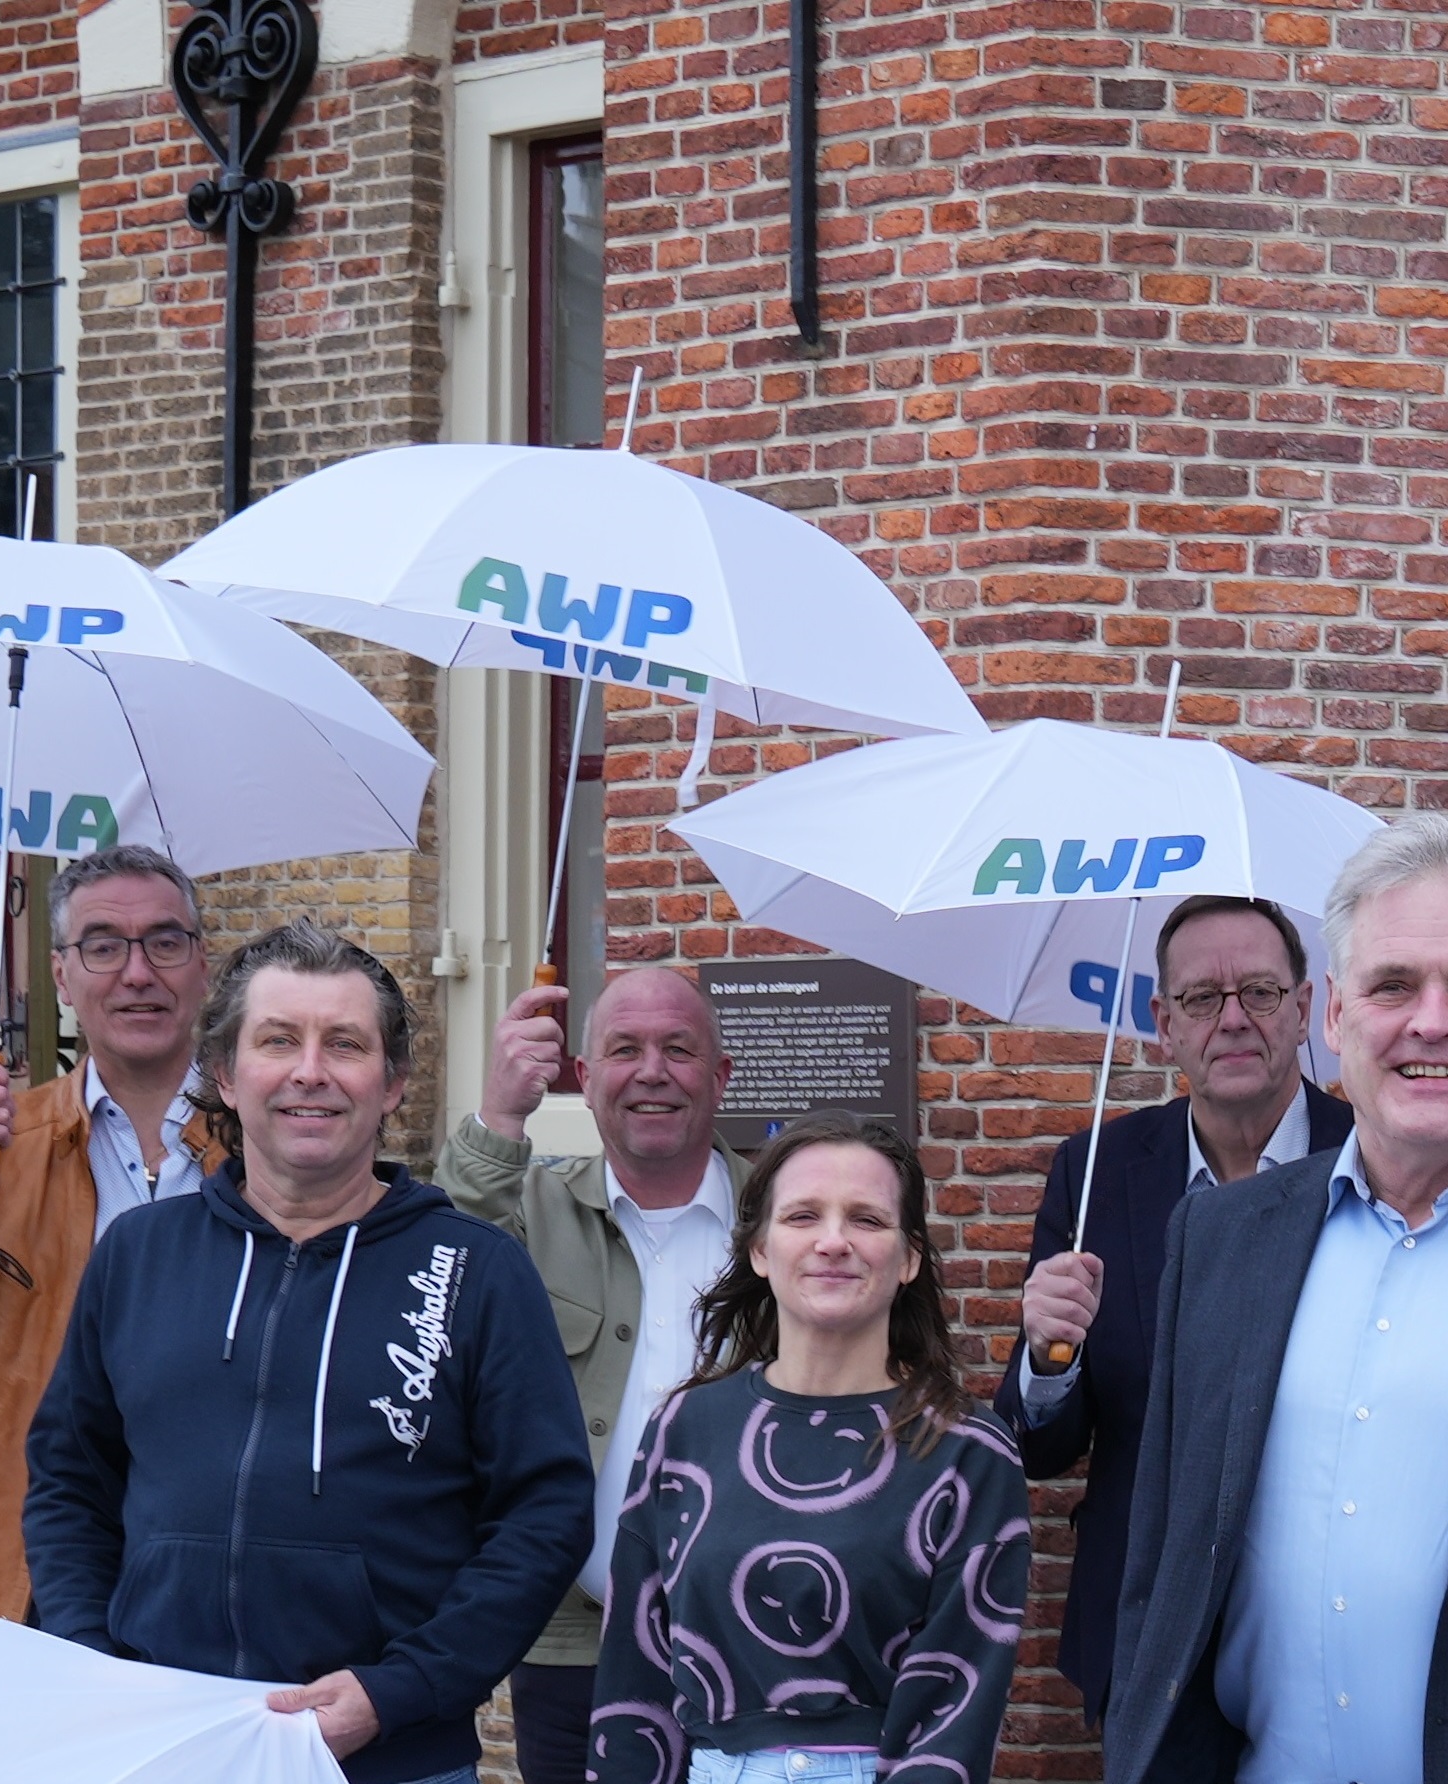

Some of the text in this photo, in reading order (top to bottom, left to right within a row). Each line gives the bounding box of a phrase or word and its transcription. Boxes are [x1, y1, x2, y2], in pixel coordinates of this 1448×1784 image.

[456, 556, 694, 650] AWP
[972, 834, 1207, 896] AWP
[387, 1244, 457, 1401] Australian
